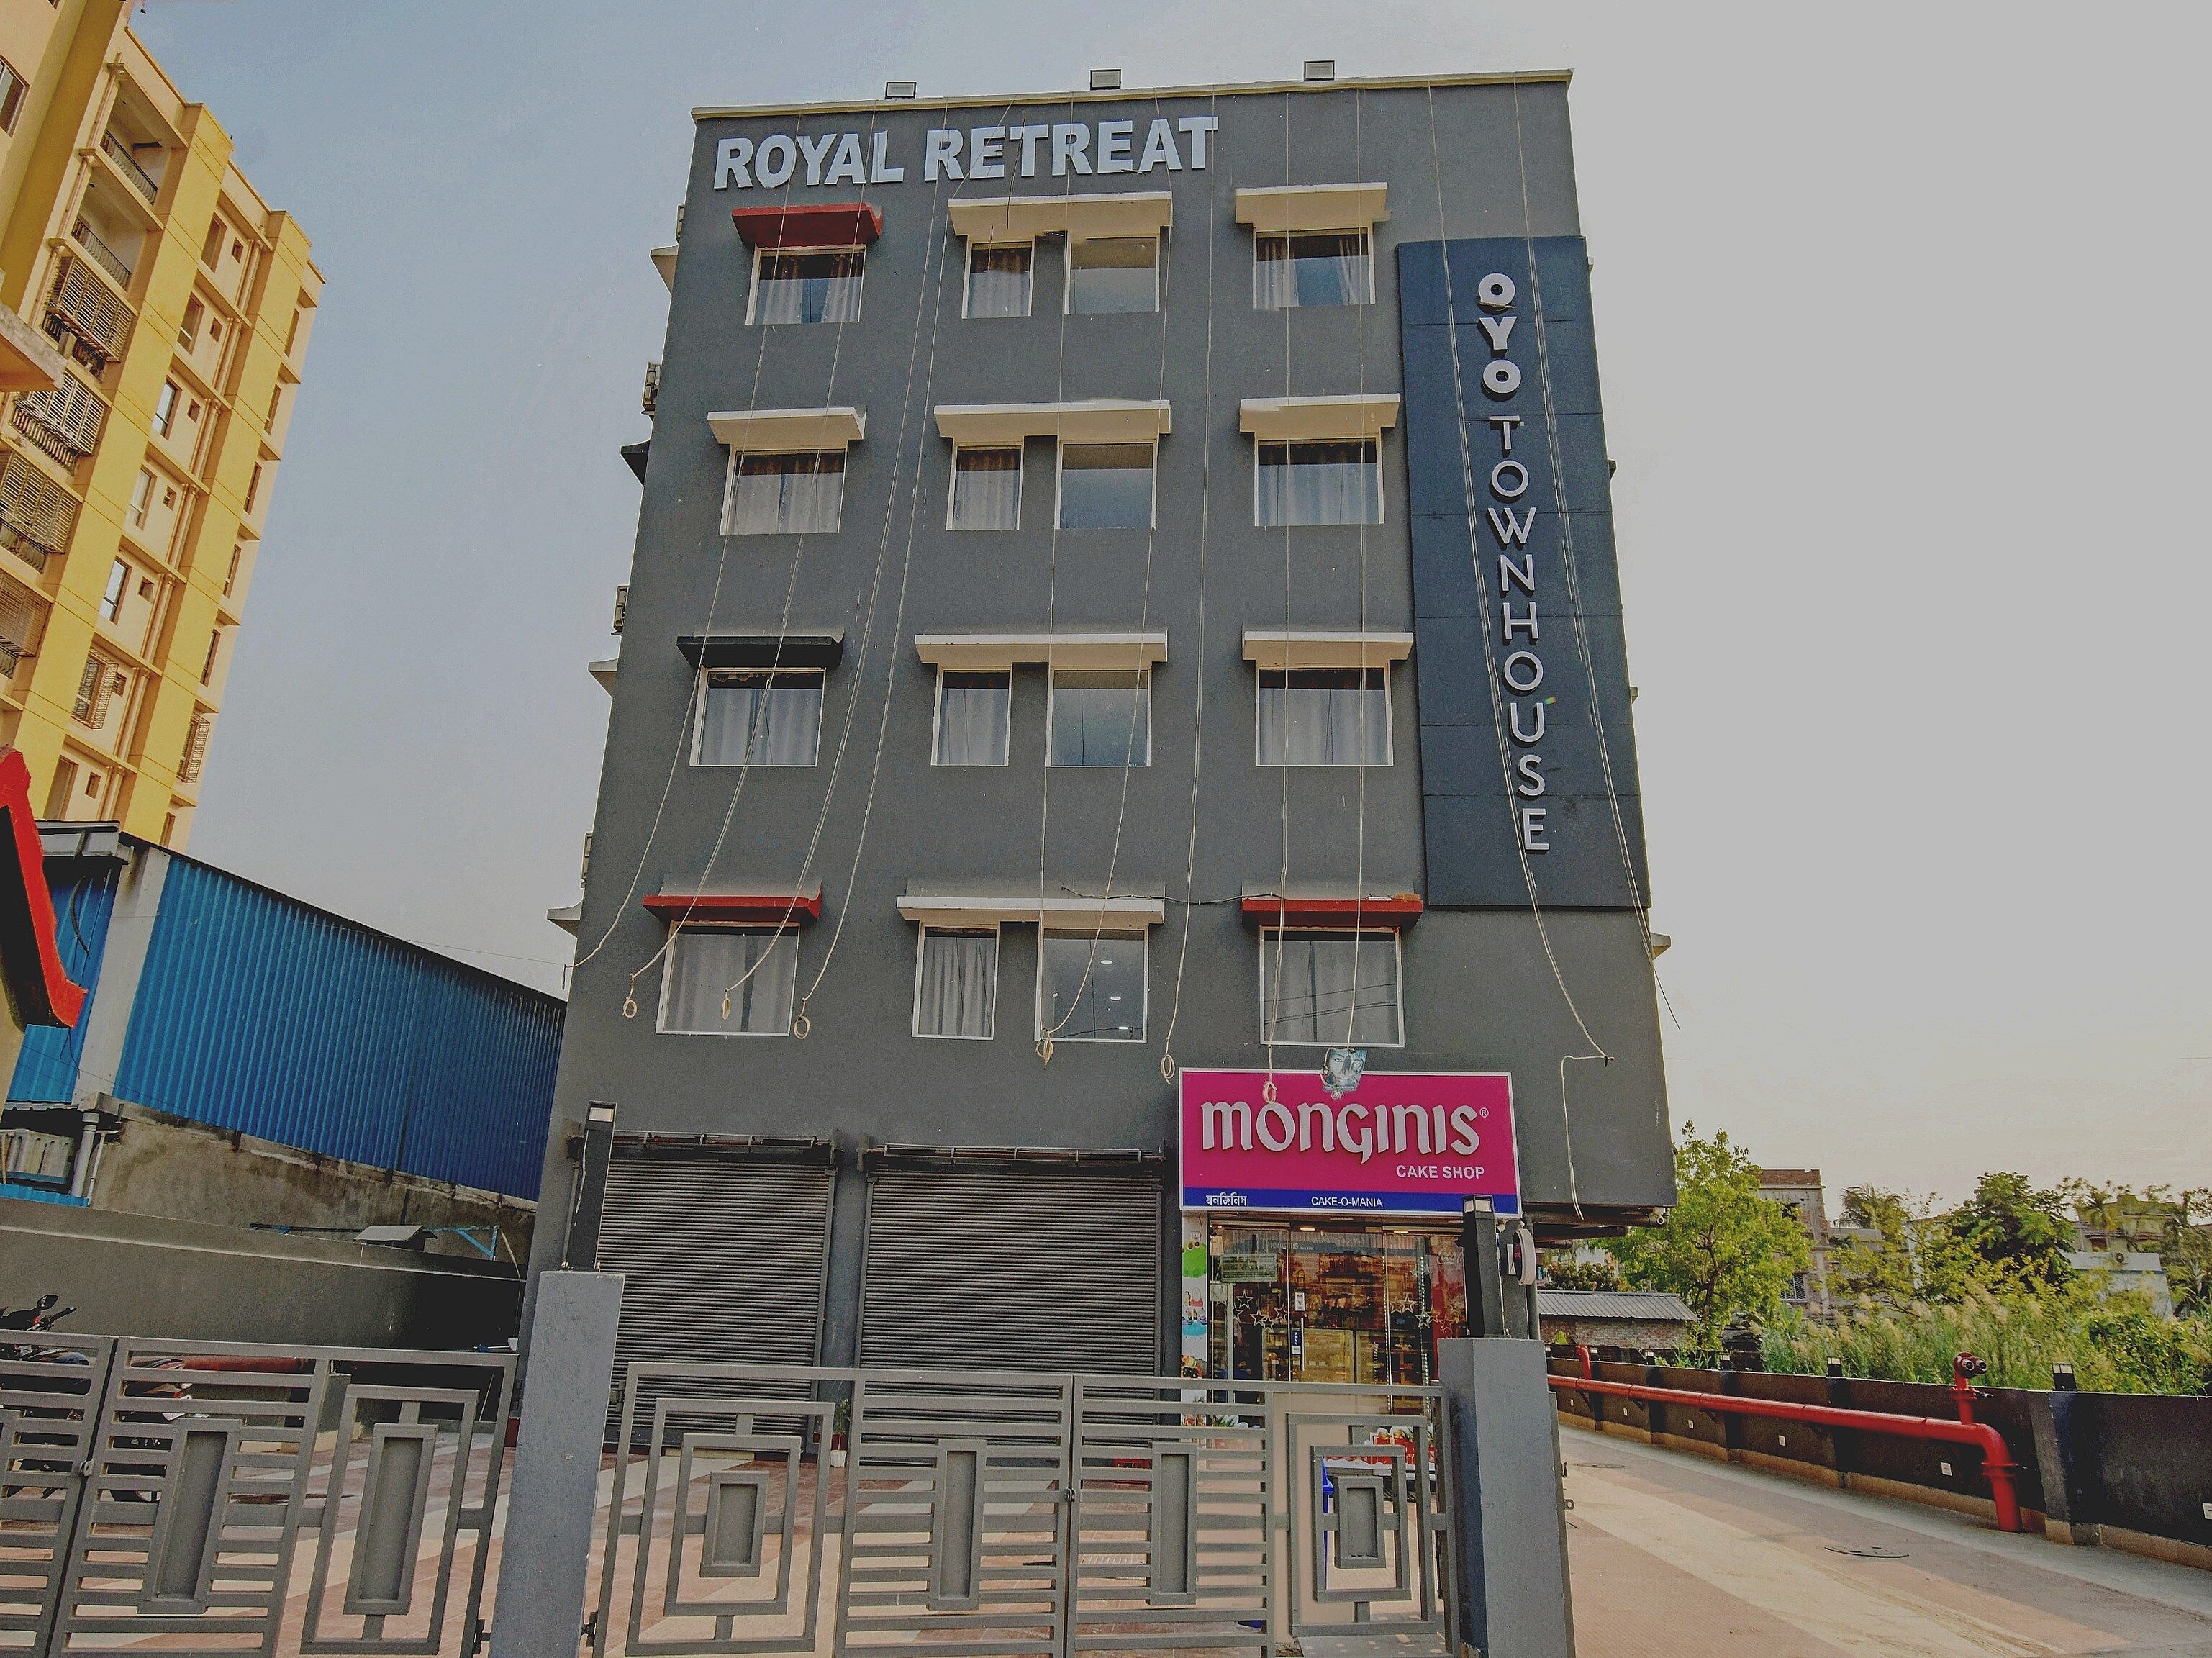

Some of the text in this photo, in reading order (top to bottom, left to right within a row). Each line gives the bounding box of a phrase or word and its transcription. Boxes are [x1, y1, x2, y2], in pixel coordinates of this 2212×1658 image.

[714, 116, 1218, 189] ROYAL RETREAT
[1477, 273, 1550, 851] OYO TOWNHOUSE
[1396, 1165, 1485, 1180] CAKE SHOP
[1206, 1192, 1247, 1206] মনজিনিস
[1311, 1196, 1384, 1208] CAKE-O-MANIA
